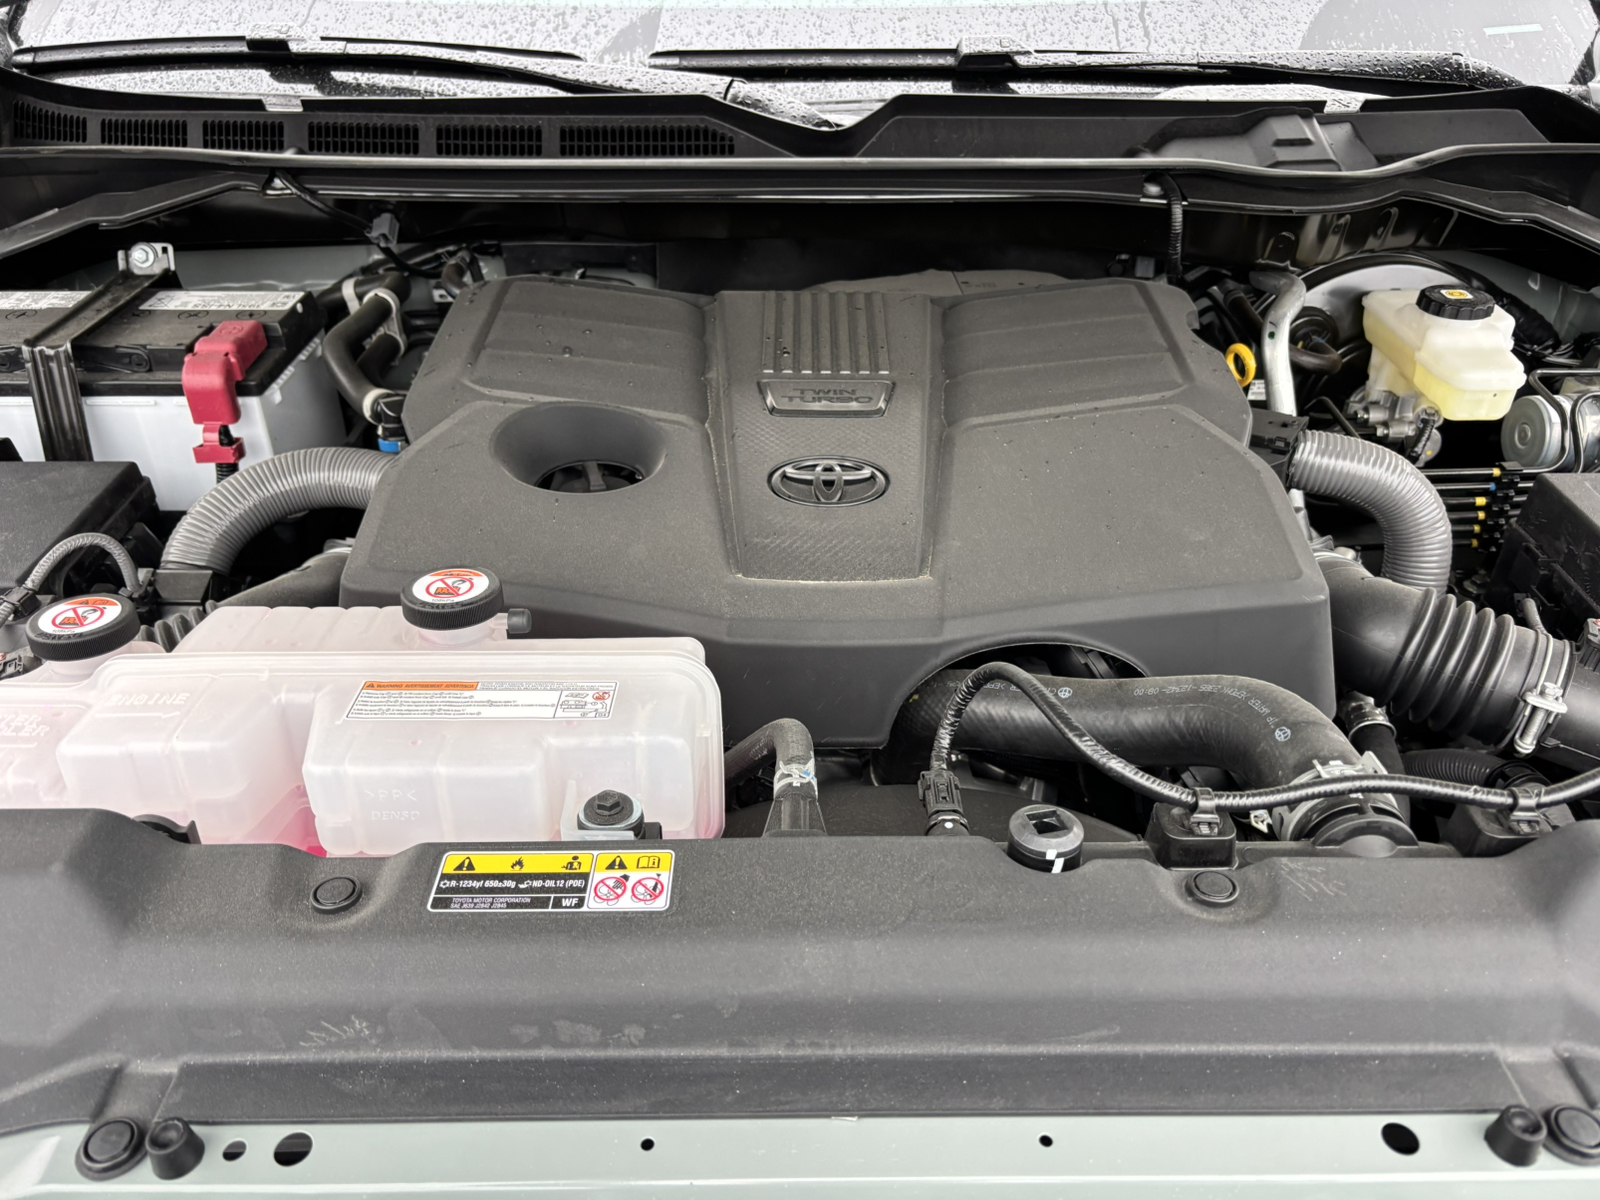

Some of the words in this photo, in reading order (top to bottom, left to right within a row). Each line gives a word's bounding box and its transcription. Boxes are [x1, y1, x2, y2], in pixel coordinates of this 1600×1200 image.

[792, 388, 857, 396] TWIN
[780, 395, 873, 404] TURBO
[102, 693, 191, 707] ENGINE
[0, 714, 42, 729] TER
[371, 810, 420, 821] DENSO
[449, 880, 484, 889] R-1234yf
[484, 880, 516, 889] 650±30g
[561, 897, 579, 907] WF
